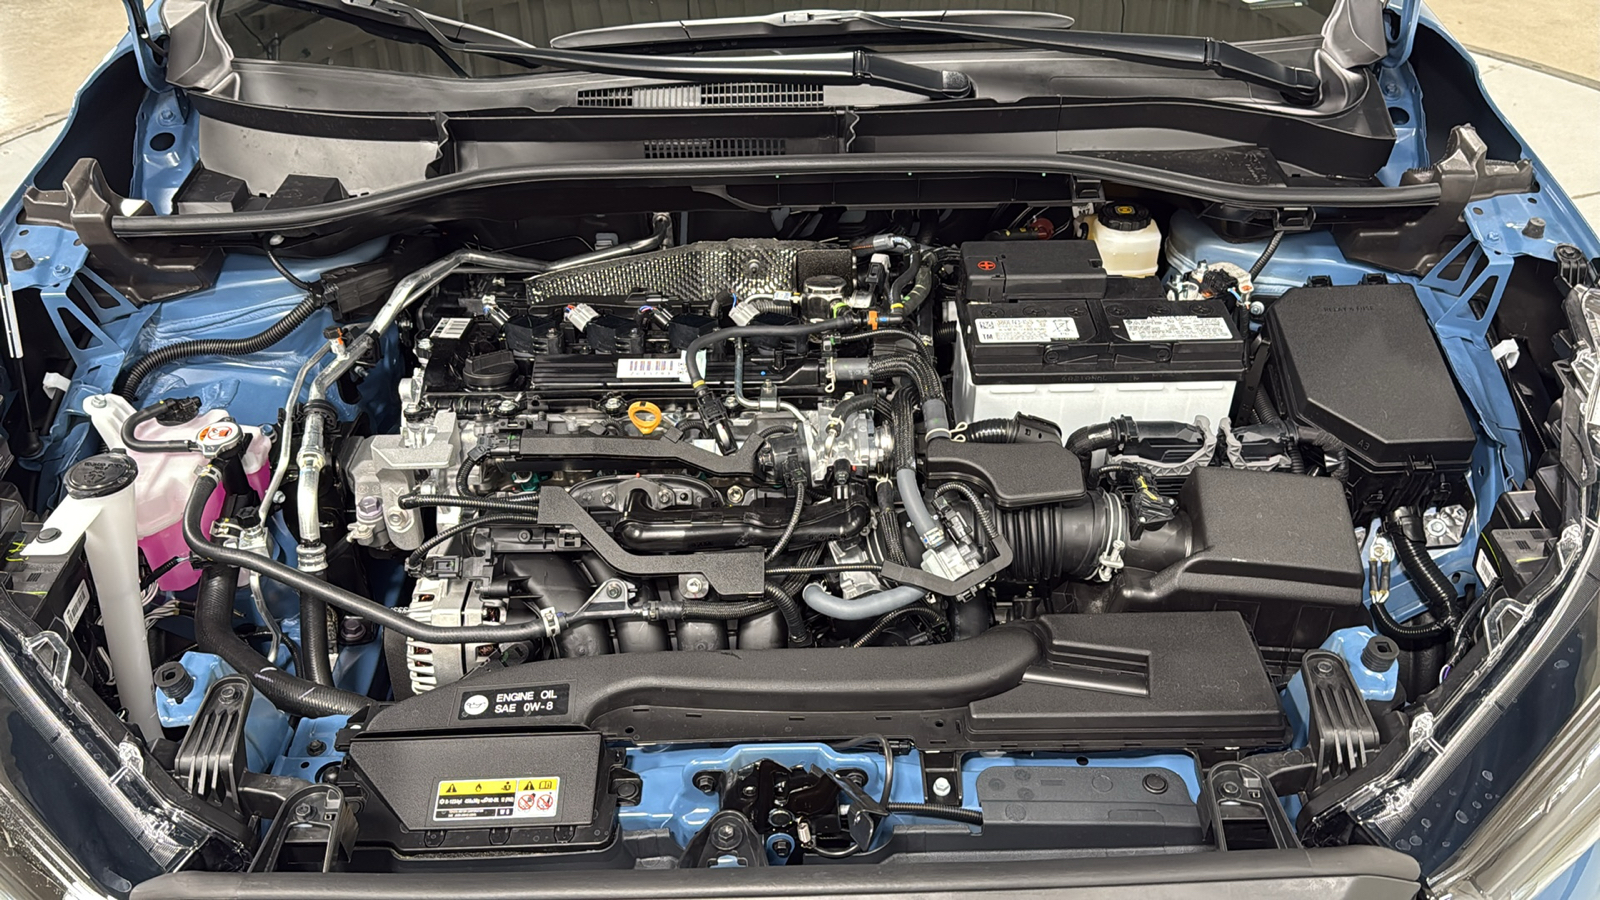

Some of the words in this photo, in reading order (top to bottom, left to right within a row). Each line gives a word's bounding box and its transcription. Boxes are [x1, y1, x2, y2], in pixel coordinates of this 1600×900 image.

[1357, 439, 1370, 451] A3
[496, 691, 535, 703] ENGINE
[540, 689, 558, 700] OIL
[494, 703, 517, 714] SAE
[523, 701, 554, 712] 0W-8
